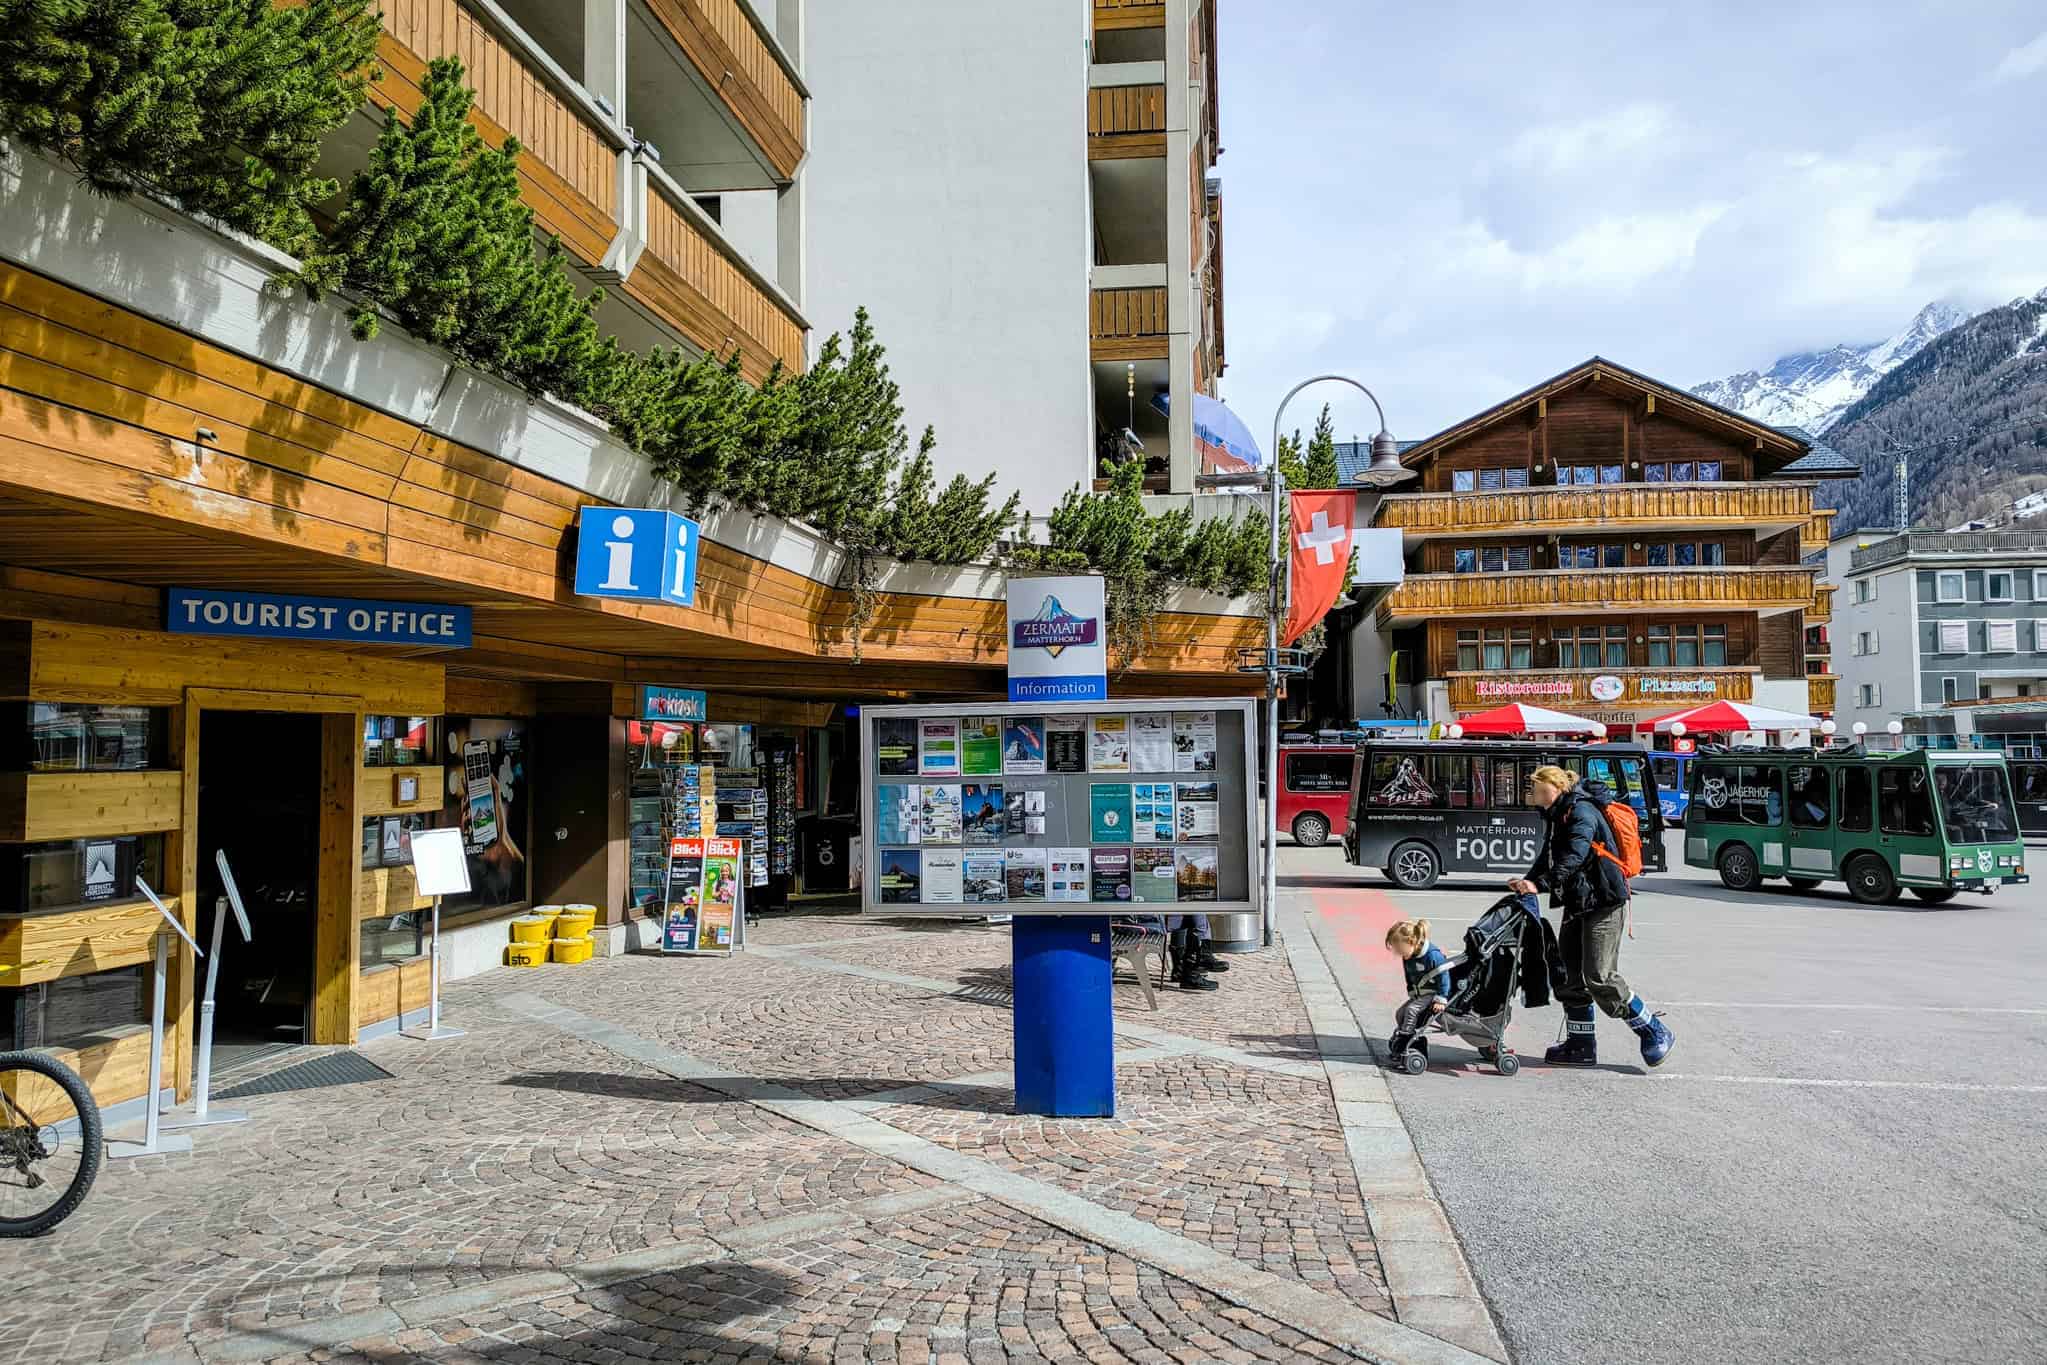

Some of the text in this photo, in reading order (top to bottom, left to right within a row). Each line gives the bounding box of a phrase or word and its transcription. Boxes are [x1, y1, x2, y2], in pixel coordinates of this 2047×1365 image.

[182, 599, 456, 636] TOURIST OFFICE
[1023, 622, 1087, 636] ZERMATT
[1027, 636, 1081, 644] MATTERHORN
[1016, 681, 1097, 695] Information
[1476, 680, 1573, 695] Ristorante
[1640, 678, 1717, 692] Pizzeria
[1456, 826, 1537, 835] MATTERHORN
[673, 843, 702, 855] Blick
[708, 842, 737, 856] Blick
[1456, 838, 1537, 861] FOCUS
[511, 953, 531, 966] sto
